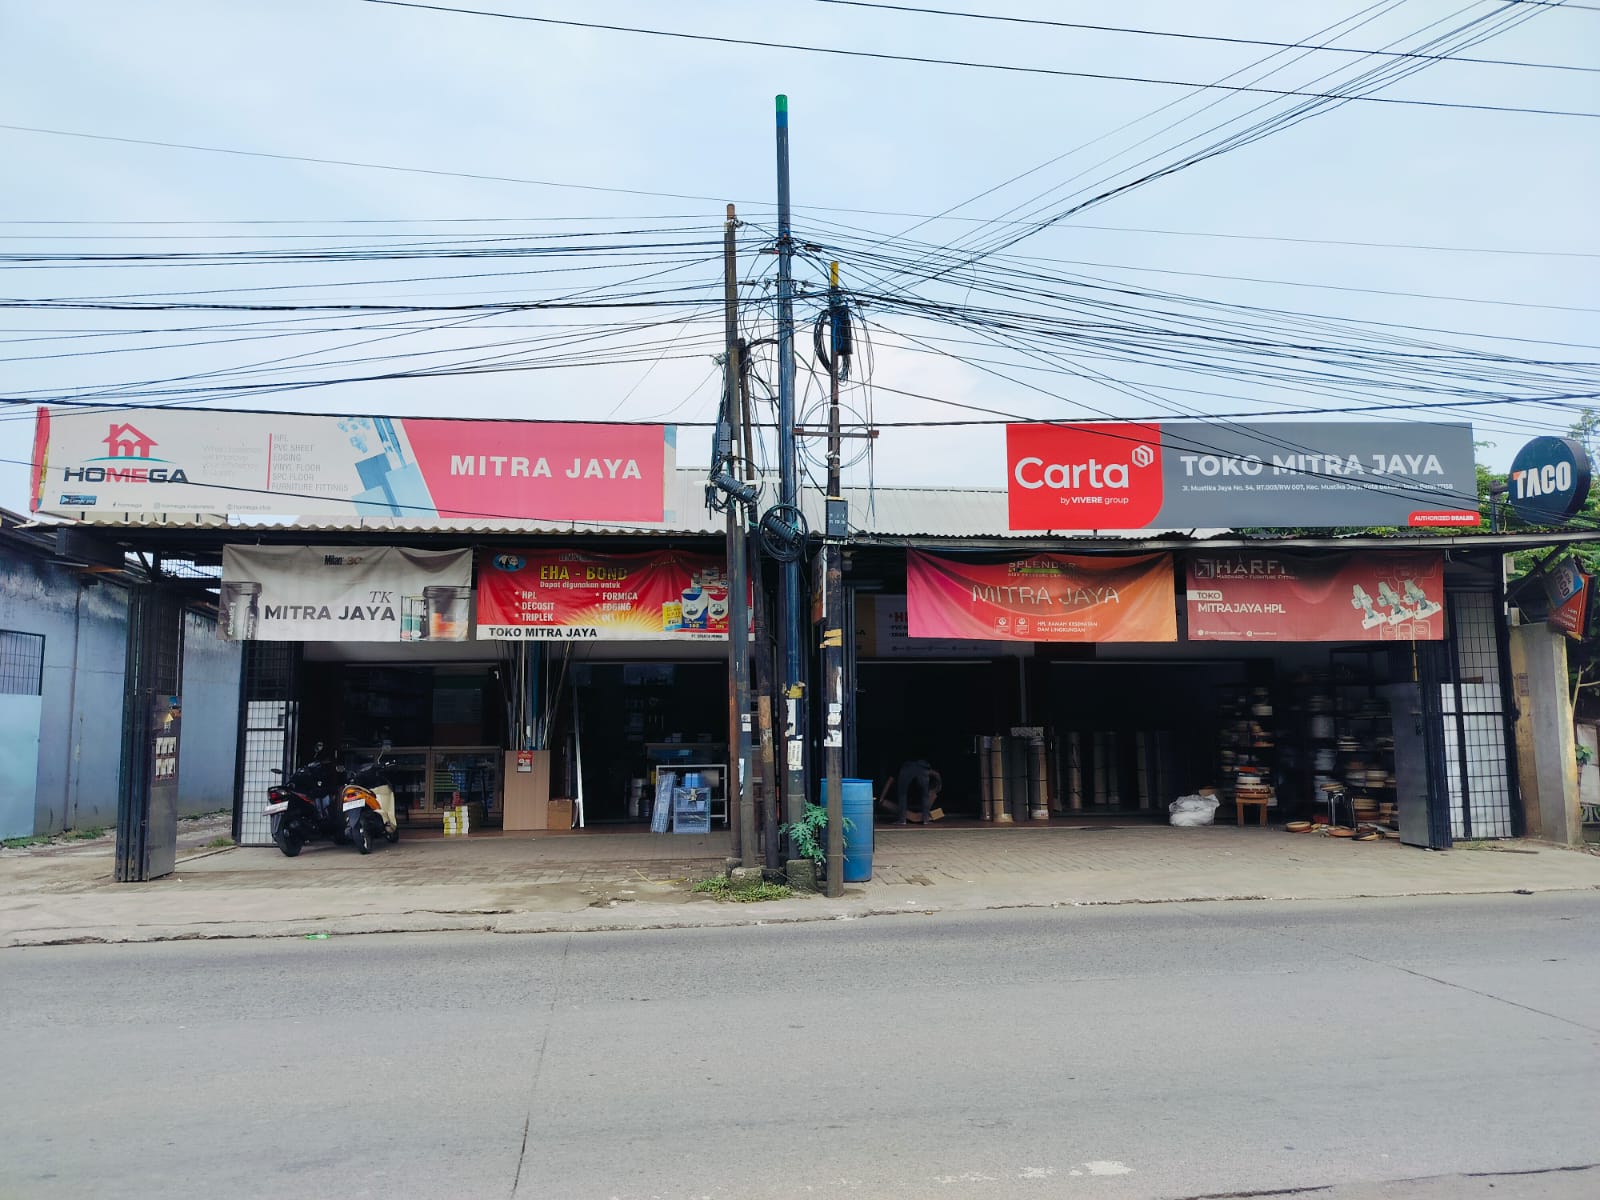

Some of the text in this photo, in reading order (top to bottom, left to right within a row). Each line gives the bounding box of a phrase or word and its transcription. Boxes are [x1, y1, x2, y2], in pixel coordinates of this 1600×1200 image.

[274, 444, 288, 452] PVC
[451, 455, 642, 479] MITRA JAYA
[1180, 454, 1444, 476] TOKO MITRA JAYA
[64, 467, 189, 483] HOMEGA
[290, 473, 314, 481] FLOOR
[1015, 457, 1129, 489] Carta
[1513, 461, 1571, 499] TACO
[271, 482, 312, 491] FURNITURE
[1060, 496, 1129, 505] by VIVERE group
[540, 565, 570, 580] EHA
[586, 566, 628, 580] BOND
[562, 581, 599, 589] digunakan
[369, 590, 394, 603] TK
[522, 591, 537, 600] HPL
[602, 592, 638, 600] FORMICA
[972, 585, 1120, 605] MITRA JAYA
[264, 605, 396, 621] MITRA JAYA
[1198, 603, 1286, 614] MITRA JAYA HPL
[489, 627, 598, 638] TOKO MITRA JAYA
